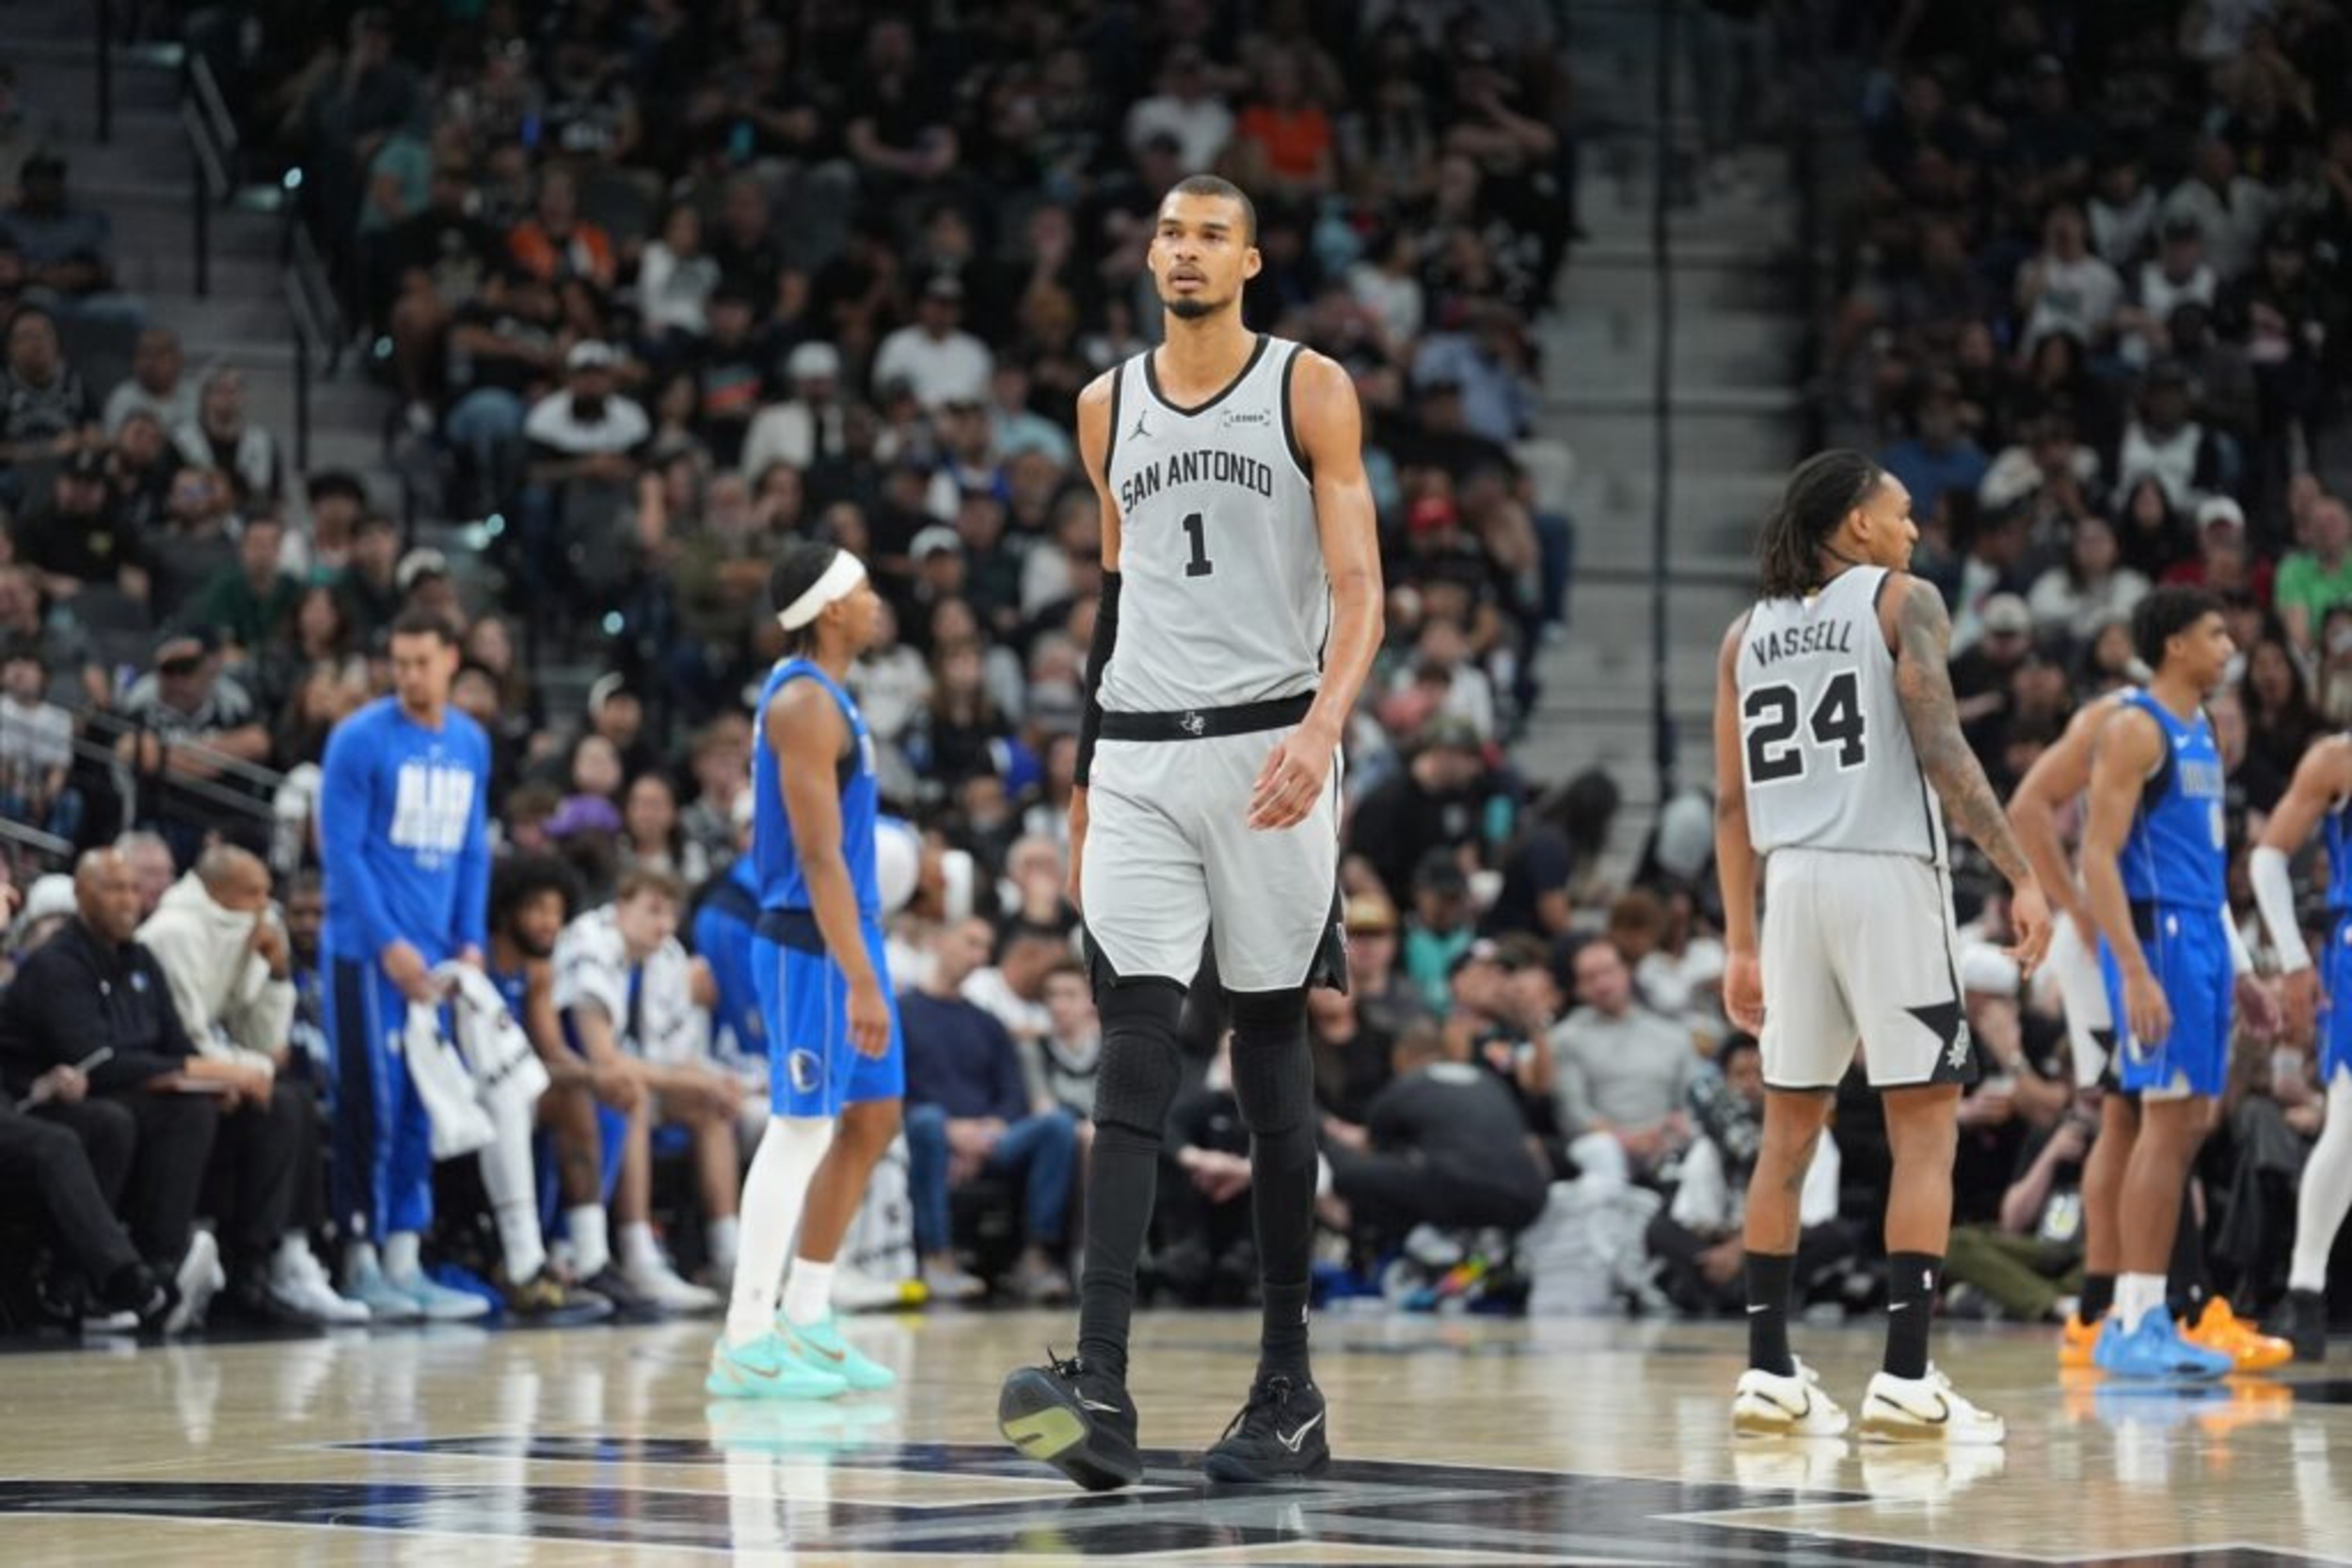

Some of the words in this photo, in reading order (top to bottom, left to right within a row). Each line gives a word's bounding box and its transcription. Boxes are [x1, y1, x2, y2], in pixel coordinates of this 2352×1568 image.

[1122, 462, 1160, 515] SAN
[1168, 450, 1272, 498] ANTONIO
[1183, 513, 1213, 577] 1
[1752, 621, 1851, 667] VASSELL
[1744, 672, 1866, 784] 24
